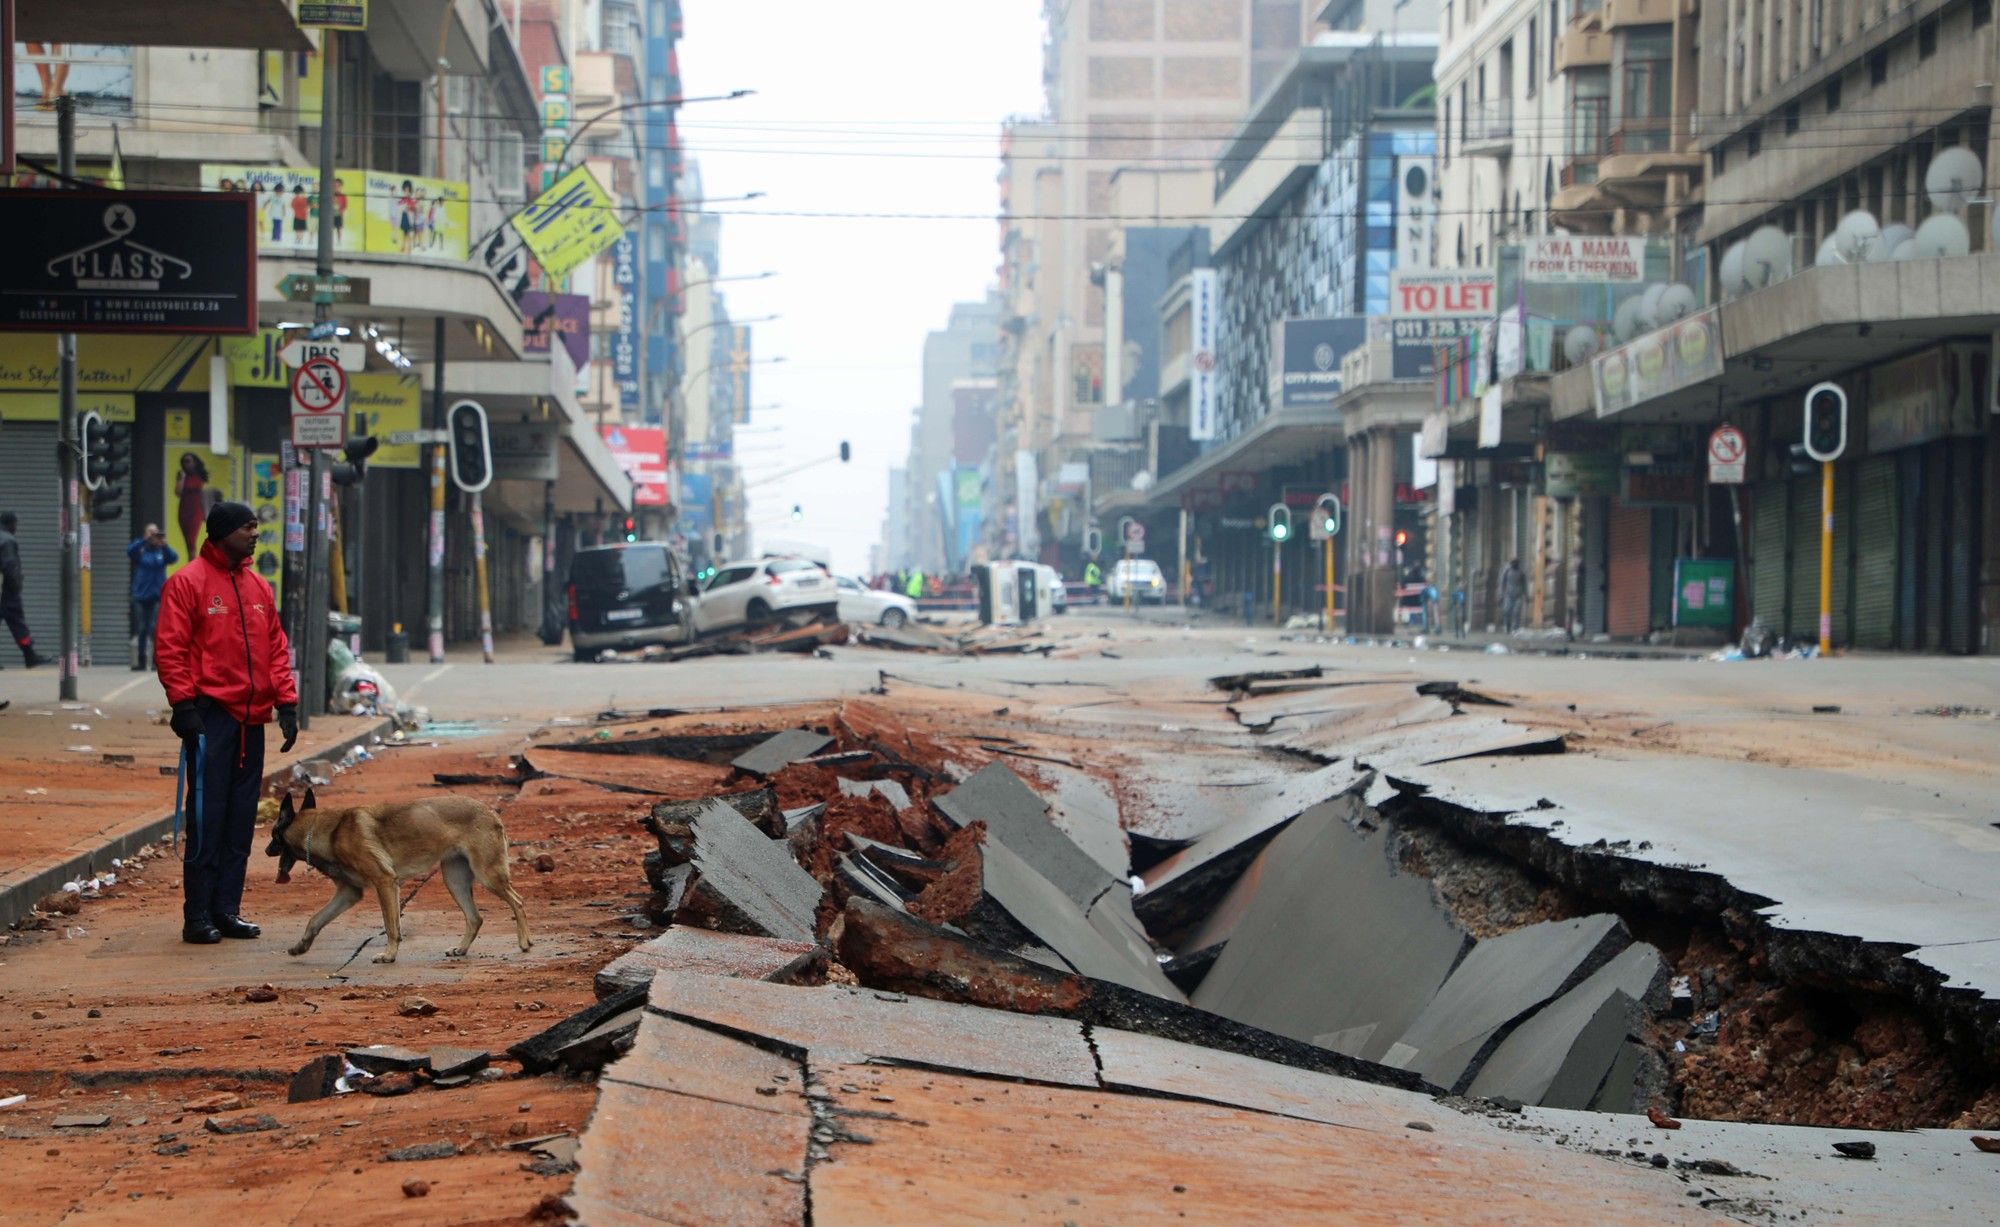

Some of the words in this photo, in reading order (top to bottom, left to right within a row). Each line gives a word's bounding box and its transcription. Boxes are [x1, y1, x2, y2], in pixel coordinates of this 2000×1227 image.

[1582, 241, 1631, 257] MAMA
[72, 253, 165, 279] CLASS
[1529, 261, 1564, 273] FROM
[1398, 284, 1437, 312] TO
[1444, 284, 1494, 311] LET
[1395, 320, 1422, 337] 011
[28, 366, 61, 388] Styl
